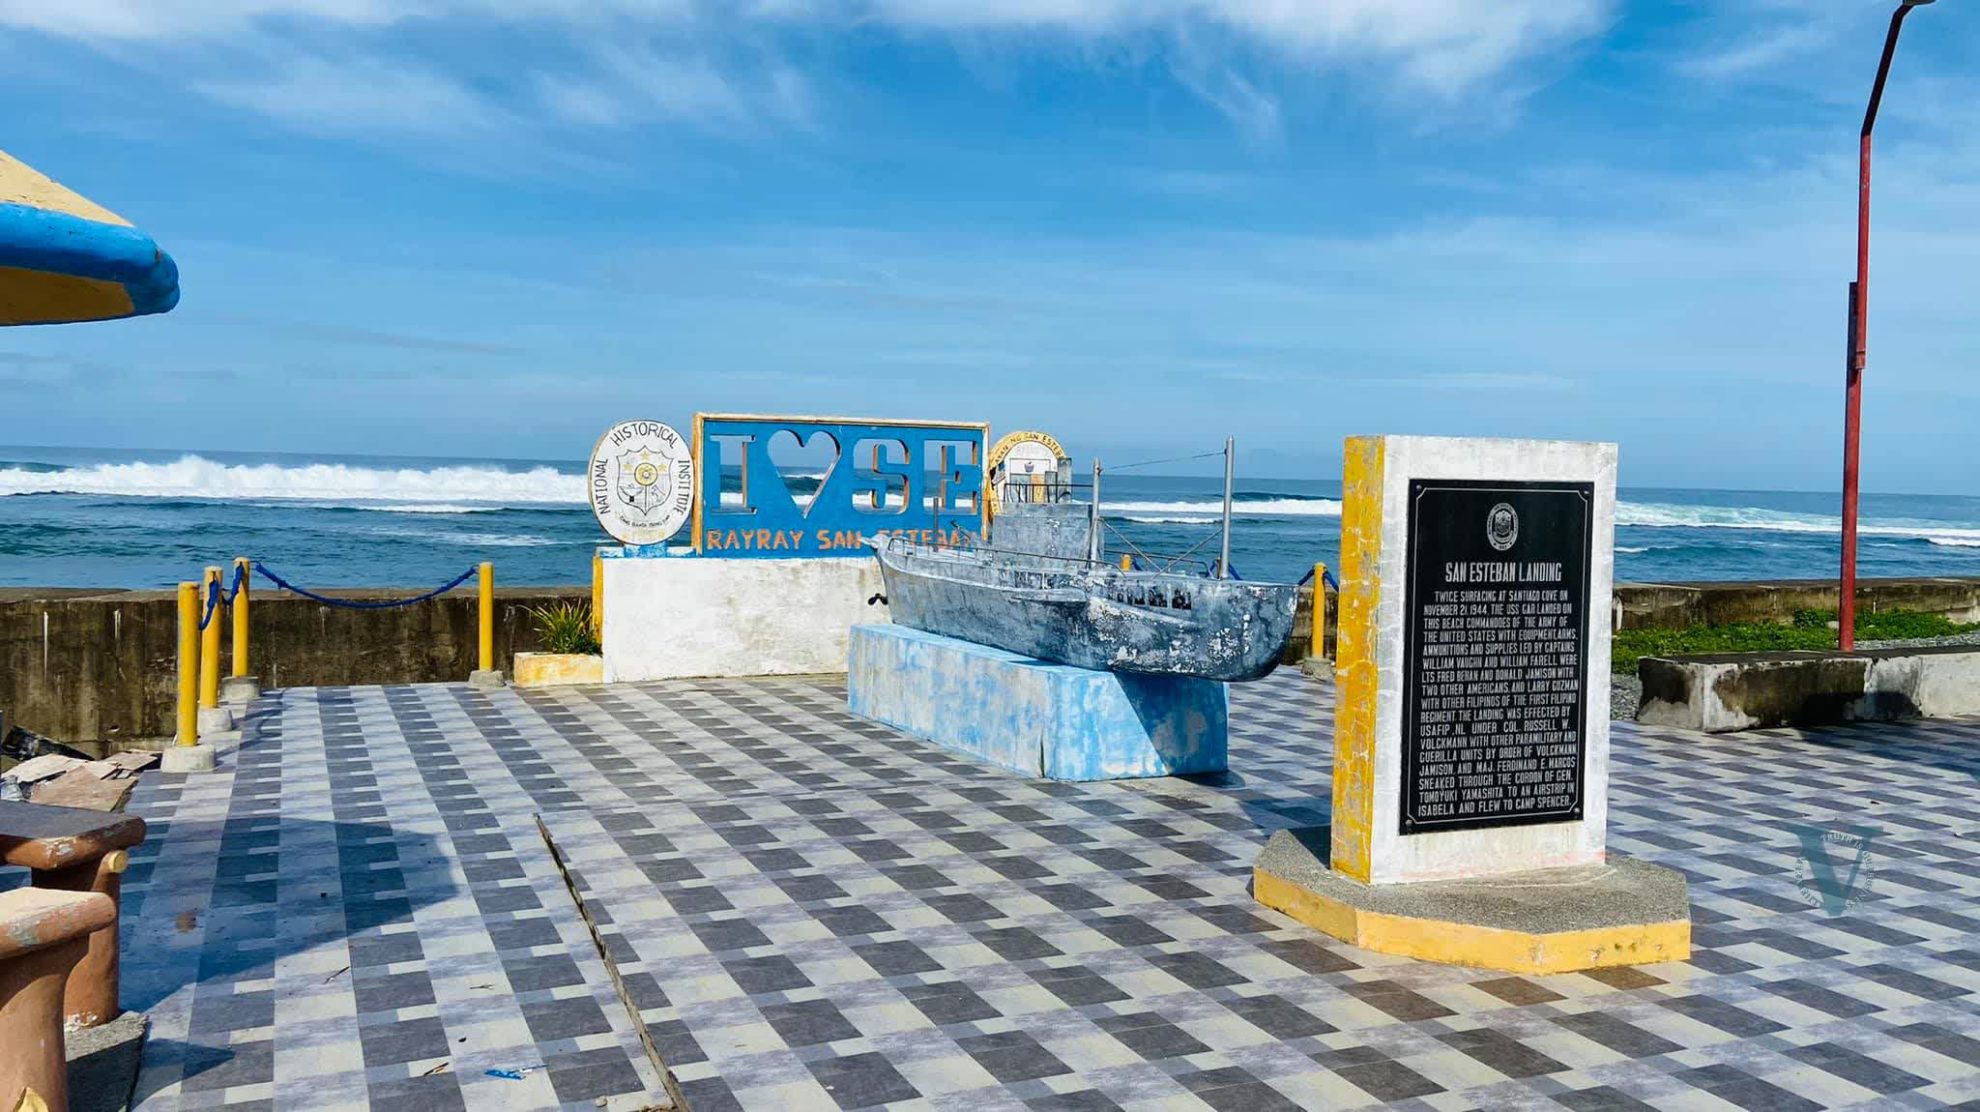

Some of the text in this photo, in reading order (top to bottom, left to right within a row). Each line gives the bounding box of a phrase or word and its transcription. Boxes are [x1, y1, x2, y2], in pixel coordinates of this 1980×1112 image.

[594, 422, 691, 516] NATIONAL HISTORICAL INSTITUTE
[706, 528, 804, 550] RAYRAY
[816, 528, 862, 550] SAN
[1445, 561, 1562, 582] SAN ESTEBAN LANDING
[1434, 591, 1458, 602] TWICE
[1498, 590, 1506, 601] AT
[1509, 590, 1540, 601] SANTIAGO
[1542, 590, 1558, 601] COVE
[1559, 590, 1568, 600] ON
[1423, 604, 1458, 616] NOVEMBER
[1491, 604, 1504, 615] THE
[1506, 604, 1519, 615] USS
[1537, 603, 1561, 614] LANDED
[1563, 603, 1572, 614] ON
[1424, 618, 1440, 629] THIS
[1442, 618, 1464, 629] BEACH
[1513, 617, 1521, 628] OF
[1524, 617, 1536, 628] THE
[1538, 616, 1556, 628] ARMY
[1559, 616, 1568, 627] OF
[1423, 631, 1438, 643] THE
[1440, 631, 1466, 643] UNITED
[1468, 630, 1496, 642] STATES
[1498, 630, 1516, 641] WITH
[1470, 644, 1484, 655] AND
[1485, 643, 1518, 655] SUPPLIES
[1520, 642, 1532, 654] LED
[1534, 642, 1544, 653] BY
[1545, 642, 1575, 653] CAPTAINS
[1423, 657, 1454, 670] WILLIAM
[1485, 656, 1498, 668] AND
[1500, 655, 1528, 667] WILLIAM
[1560, 654, 1578, 665] WERE
[1422, 671, 1435, 683] LTS
[1437, 671, 1455, 683] FRED
[1480, 670, 1494, 681] AND
[1495, 669, 1523, 680] DONALD
[1525, 668, 1556, 680] JAMISON
[1558, 667, 1574, 678] WITH
[1422, 685, 1438, 696] TWO
[1440, 684, 1464, 695] OTHER
[1512, 682, 1525, 693] AND
[1552, 680, 1578, 691] GUZMAN
[1421, 693, 1576, 710] WITH OTHER FILIPINOS OF THE FIRST FILIPINO
[1459, 710, 1472, 722] THE
[1474, 709, 1504, 720] LANDING
[1507, 708, 1522, 719] WAS
[1524, 706, 1559, 718] EFFECTED
[1561, 706, 1570, 717] BY
[1472, 722, 1497, 734] UNDER
[1524, 719, 1557, 732] RUSSELL
[1562, 719, 1570, 730] W.
[1470, 736, 1489, 747] WITH
[1491, 735, 1513, 746] OTHER
[1564, 731, 1576, 742] AND
[1420, 751, 1457, 763] GUERILLA
[1460, 749, 1482, 761] UNITS
[1485, 748, 1496, 760] BY
[1500, 747, 1522, 758] ORDER
[1524, 746, 1533, 757] OF
[1458, 763, 1472, 774] AND
[1497, 759, 1537, 772] FERDINAND
[1549, 757, 1576, 769] MARCOS
[1419, 769, 1573, 790] SNEAKED THROUGH THE CORDON OF GEN.
[1419, 782, 1574, 803] TOMOYUKI YAMASHITA TO AN AIRSTRIP IN
[1418, 796, 1571, 816] ISABELA AND FLEW TO CAMP SPENCER.
